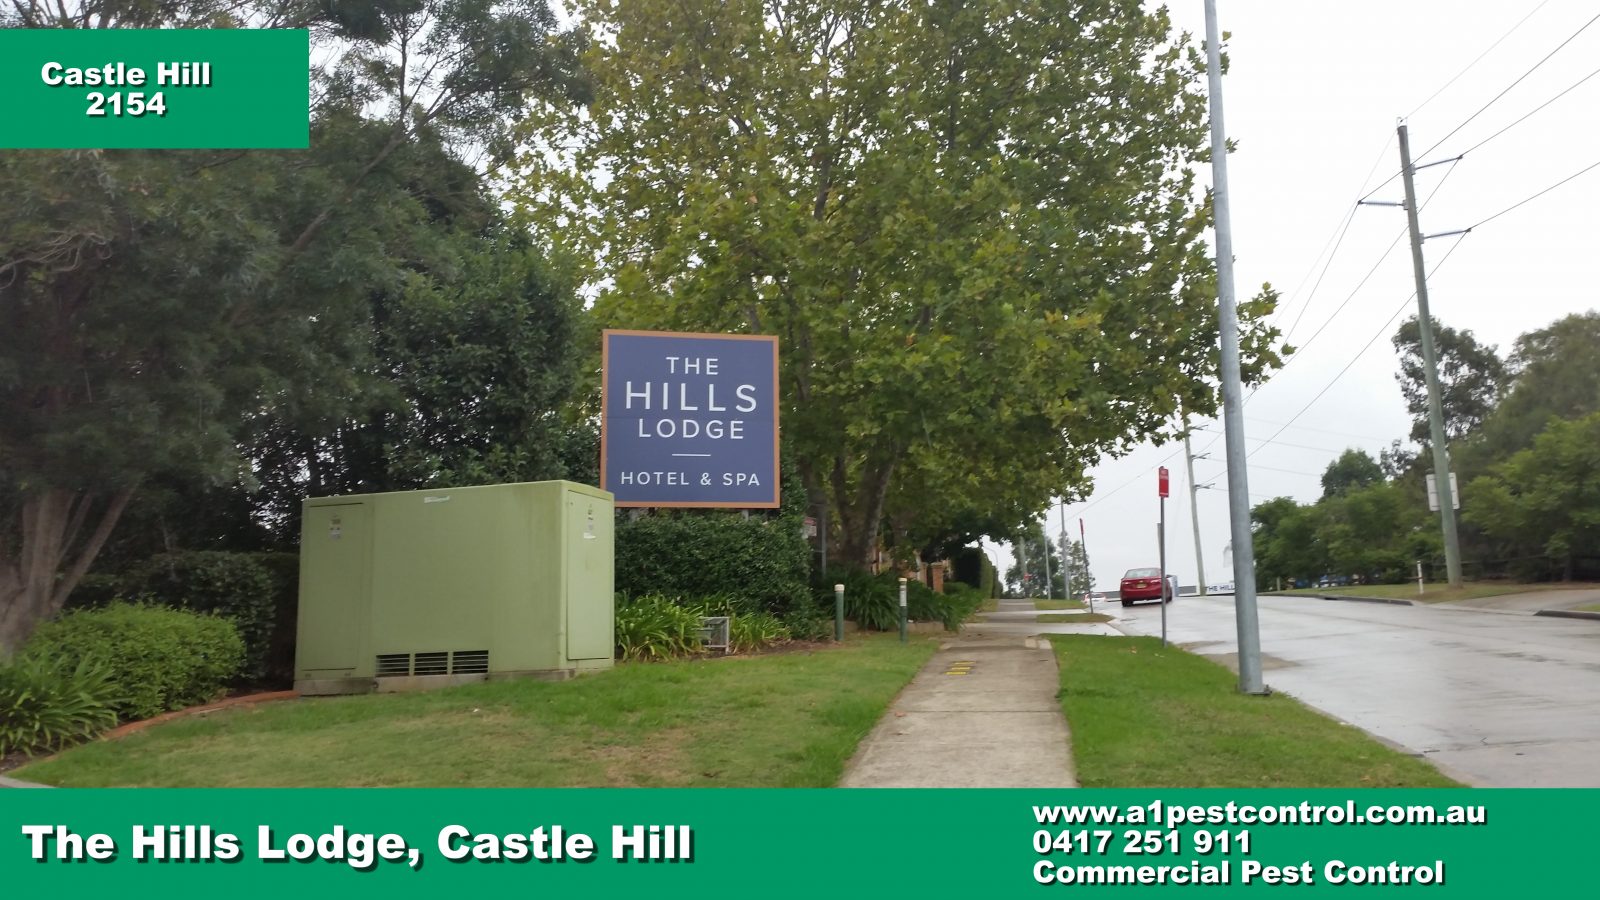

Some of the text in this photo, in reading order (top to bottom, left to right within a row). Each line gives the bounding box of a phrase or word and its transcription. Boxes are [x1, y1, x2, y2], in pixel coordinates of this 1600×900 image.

[665, 356, 719, 376] THE
[625, 381, 757, 413] HILLS
[638, 418, 744, 440] LODGE
[620, 471, 760, 486] HOTEL & SPA
